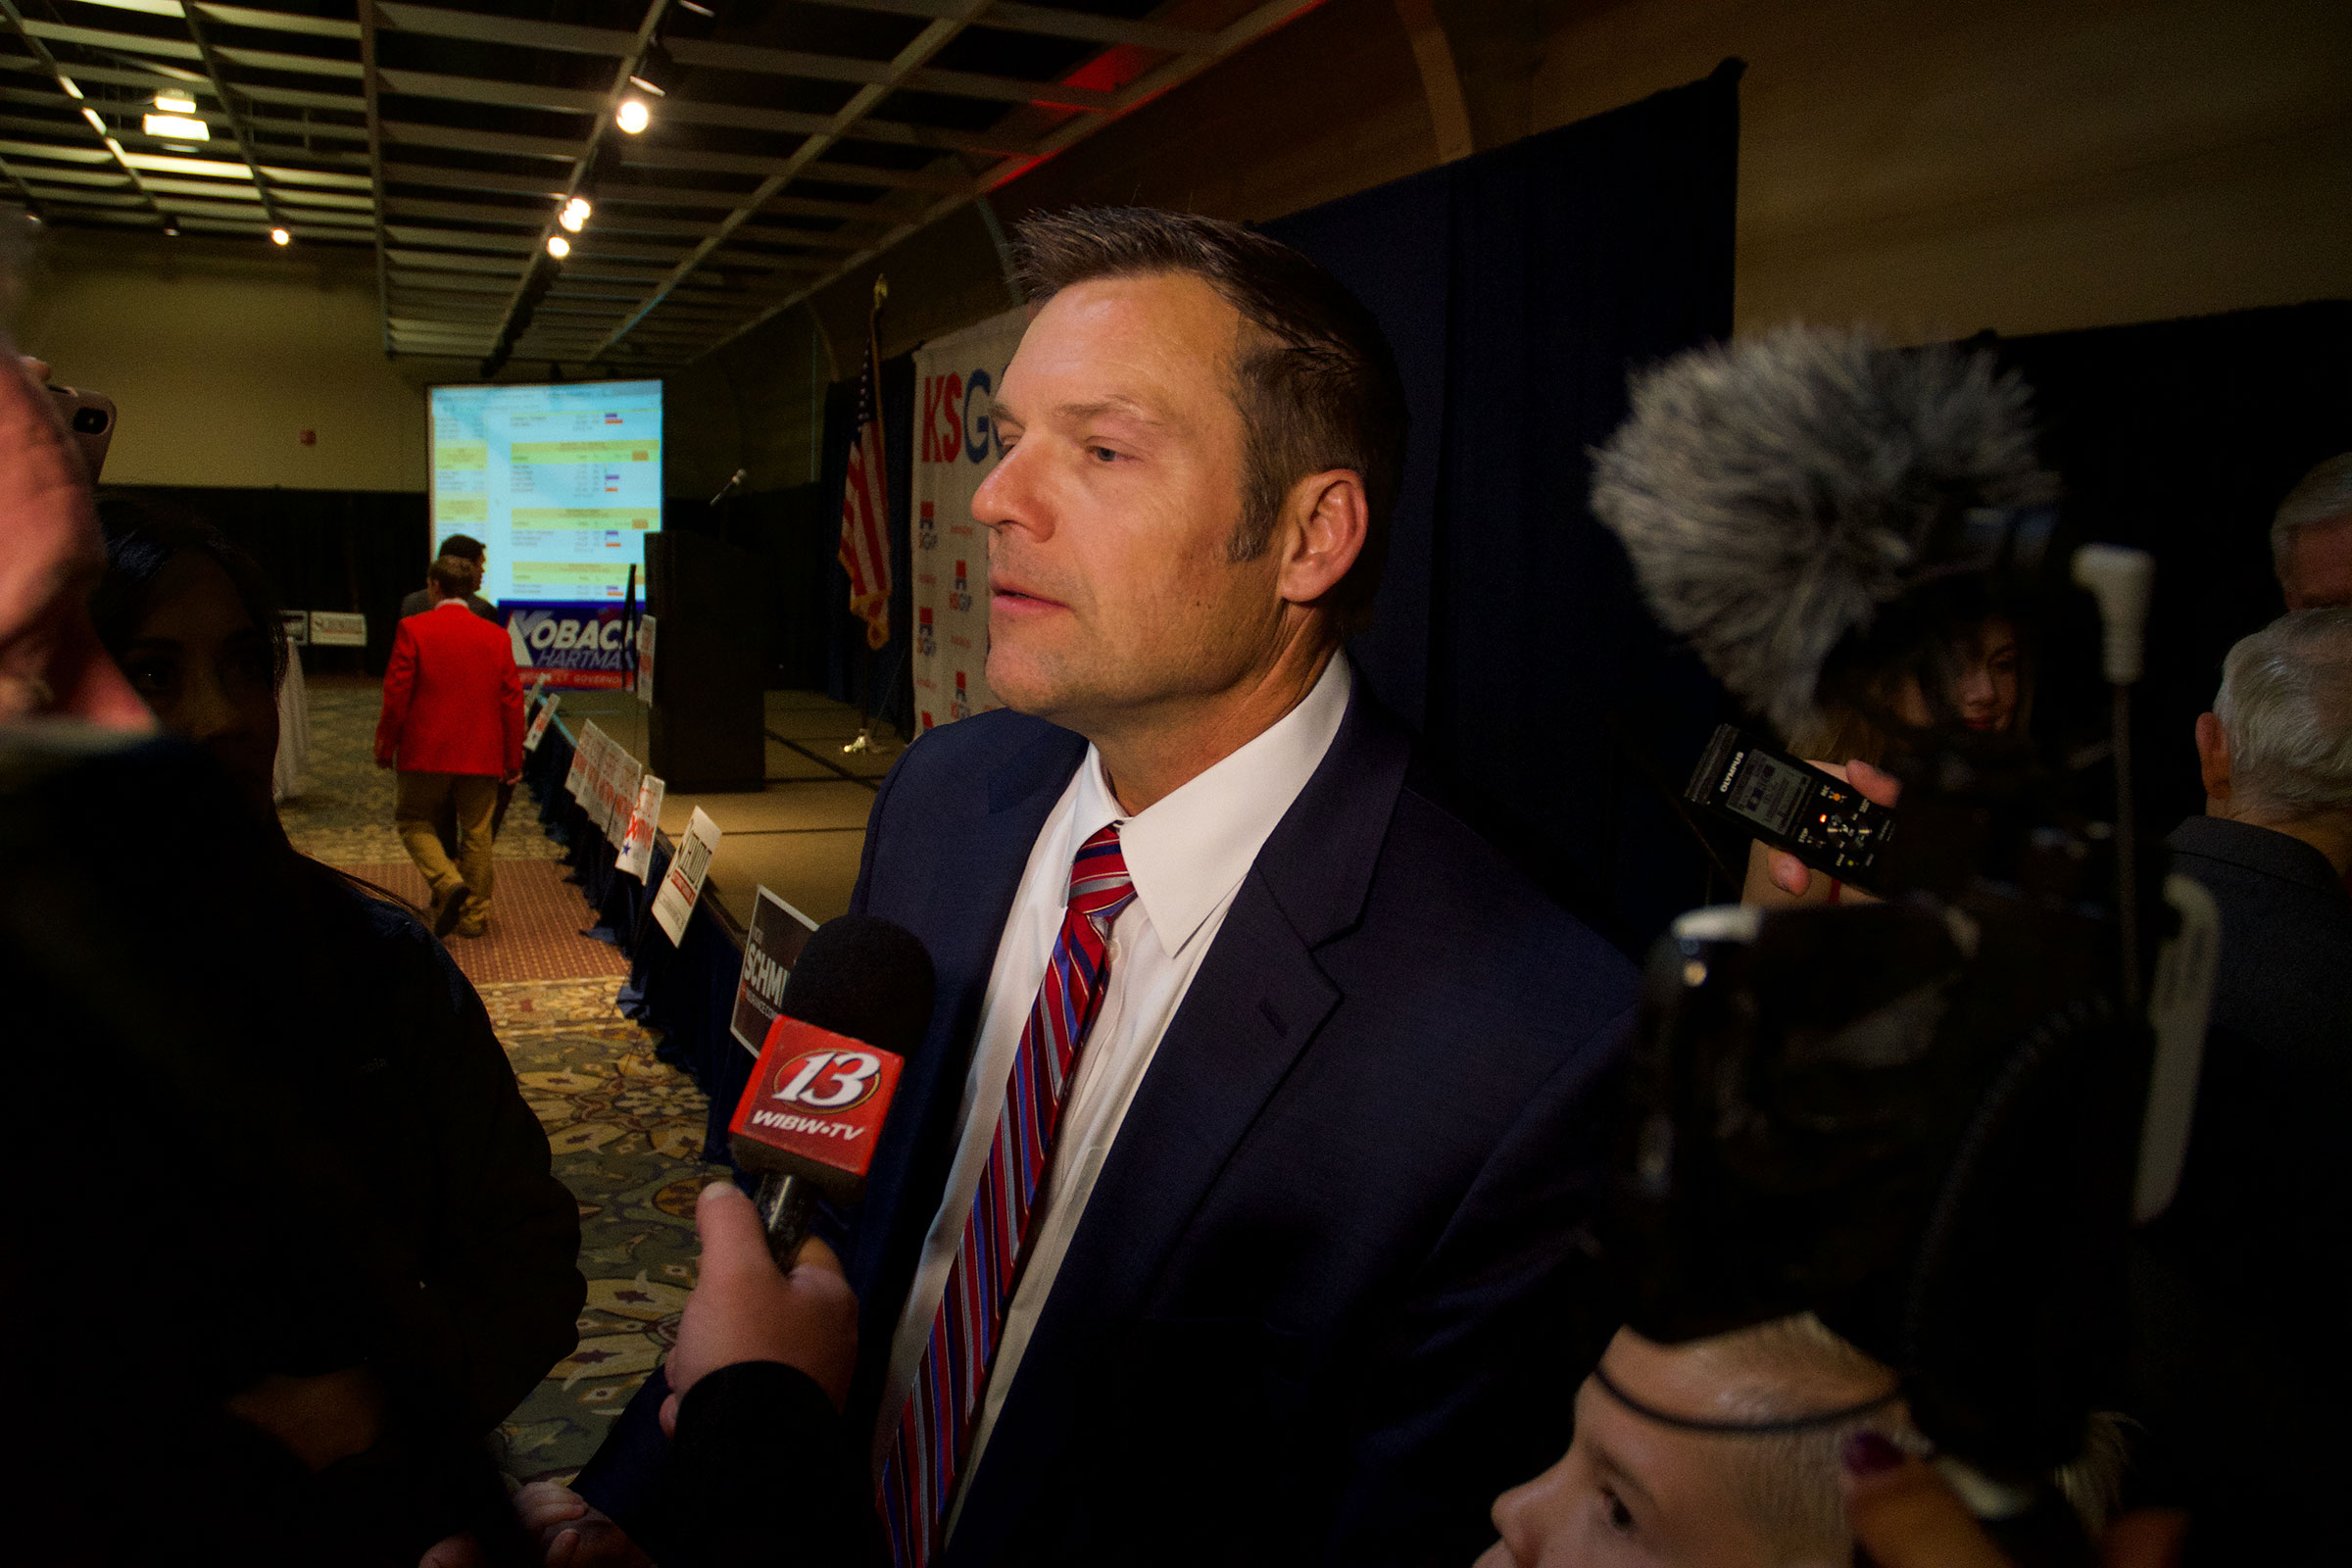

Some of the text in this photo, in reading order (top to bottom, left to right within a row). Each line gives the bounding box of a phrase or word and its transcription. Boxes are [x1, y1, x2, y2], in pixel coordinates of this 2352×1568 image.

[1719, 751, 1744, 793] OLYMPUS
[744, 942, 790, 1008] SCHMI
[771, 1052, 881, 1107] 13
